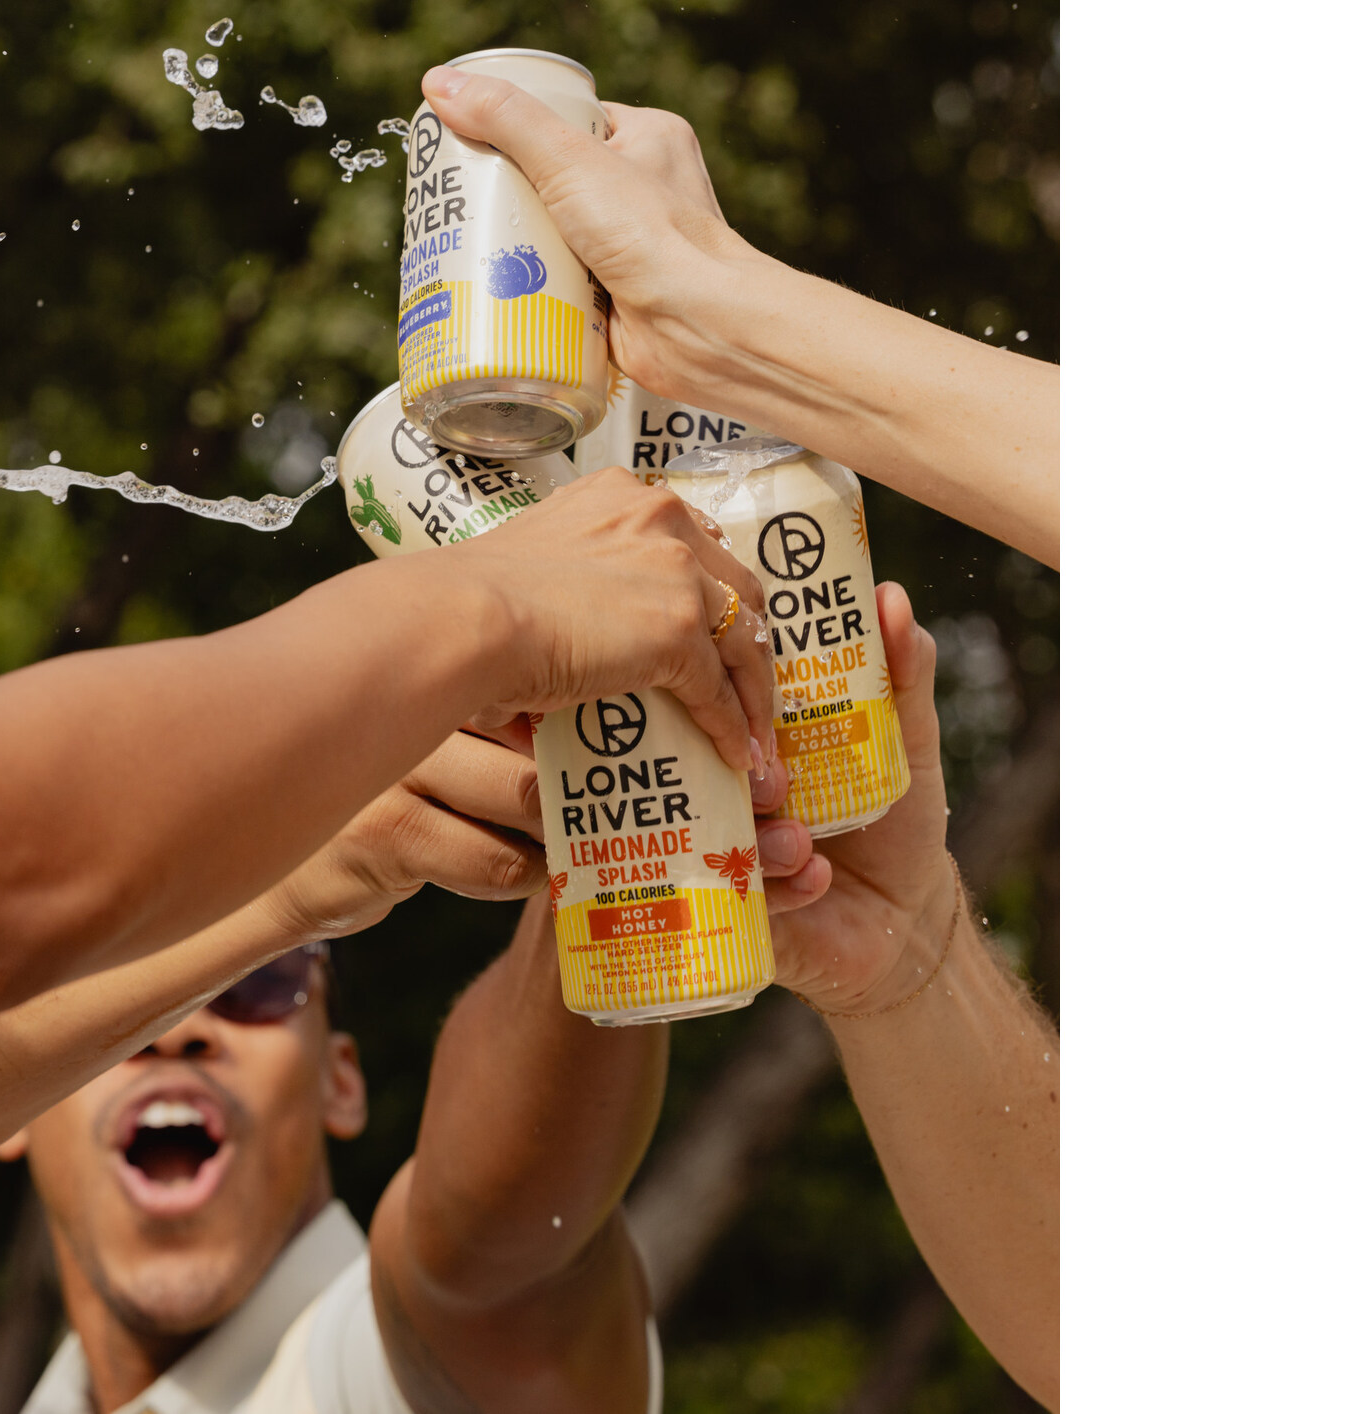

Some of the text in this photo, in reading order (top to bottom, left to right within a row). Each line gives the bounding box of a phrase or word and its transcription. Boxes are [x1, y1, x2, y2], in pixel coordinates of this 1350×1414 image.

[405, 165, 462, 215] ONE
[405, 197, 466, 250] IVER
[403, 260, 439, 296] SPLASH
[410, 279, 443, 304] CALORIES
[399, 299, 448, 338] BLUEBERRY
[425, 469, 530, 547] RIVER
[449, 488, 542, 545] EMONADE
[768, 575, 856, 620] ONE
[771, 609, 866, 656] IVER
[775, 642, 867, 686] MONADE
[782, 676, 849, 705] SPLASH
[782, 699, 853, 724] 90 CALORIES
[790, 719, 853, 741] CLASSIC
[798, 733, 849, 753] AGAVE
[561, 756, 682, 800] LONE
[562, 793, 692, 836] RIVER
[570, 828, 693, 867] LEMONADE
[597, 861, 668, 887] SPLASH
[595, 884, 676, 905] 100 CALORIES
[612, 919, 666, 935] HONEY
[621, 907, 653, 920] HOT
[567, 926, 733, 953] FLAVORED WITH OTHER NATURAL FLAVORS
[608, 943, 682, 958] HARD SELTZER
[590, 952, 705, 971] WITH THE TASTE OF CITRUSY
[603, 970, 630, 978] LEMON
[640, 966, 658, 975] HOT
[661, 961, 691, 972] HONEY
[667, 975, 680, 987] 4%
[683, 969, 719, 985] ALC/VOL
